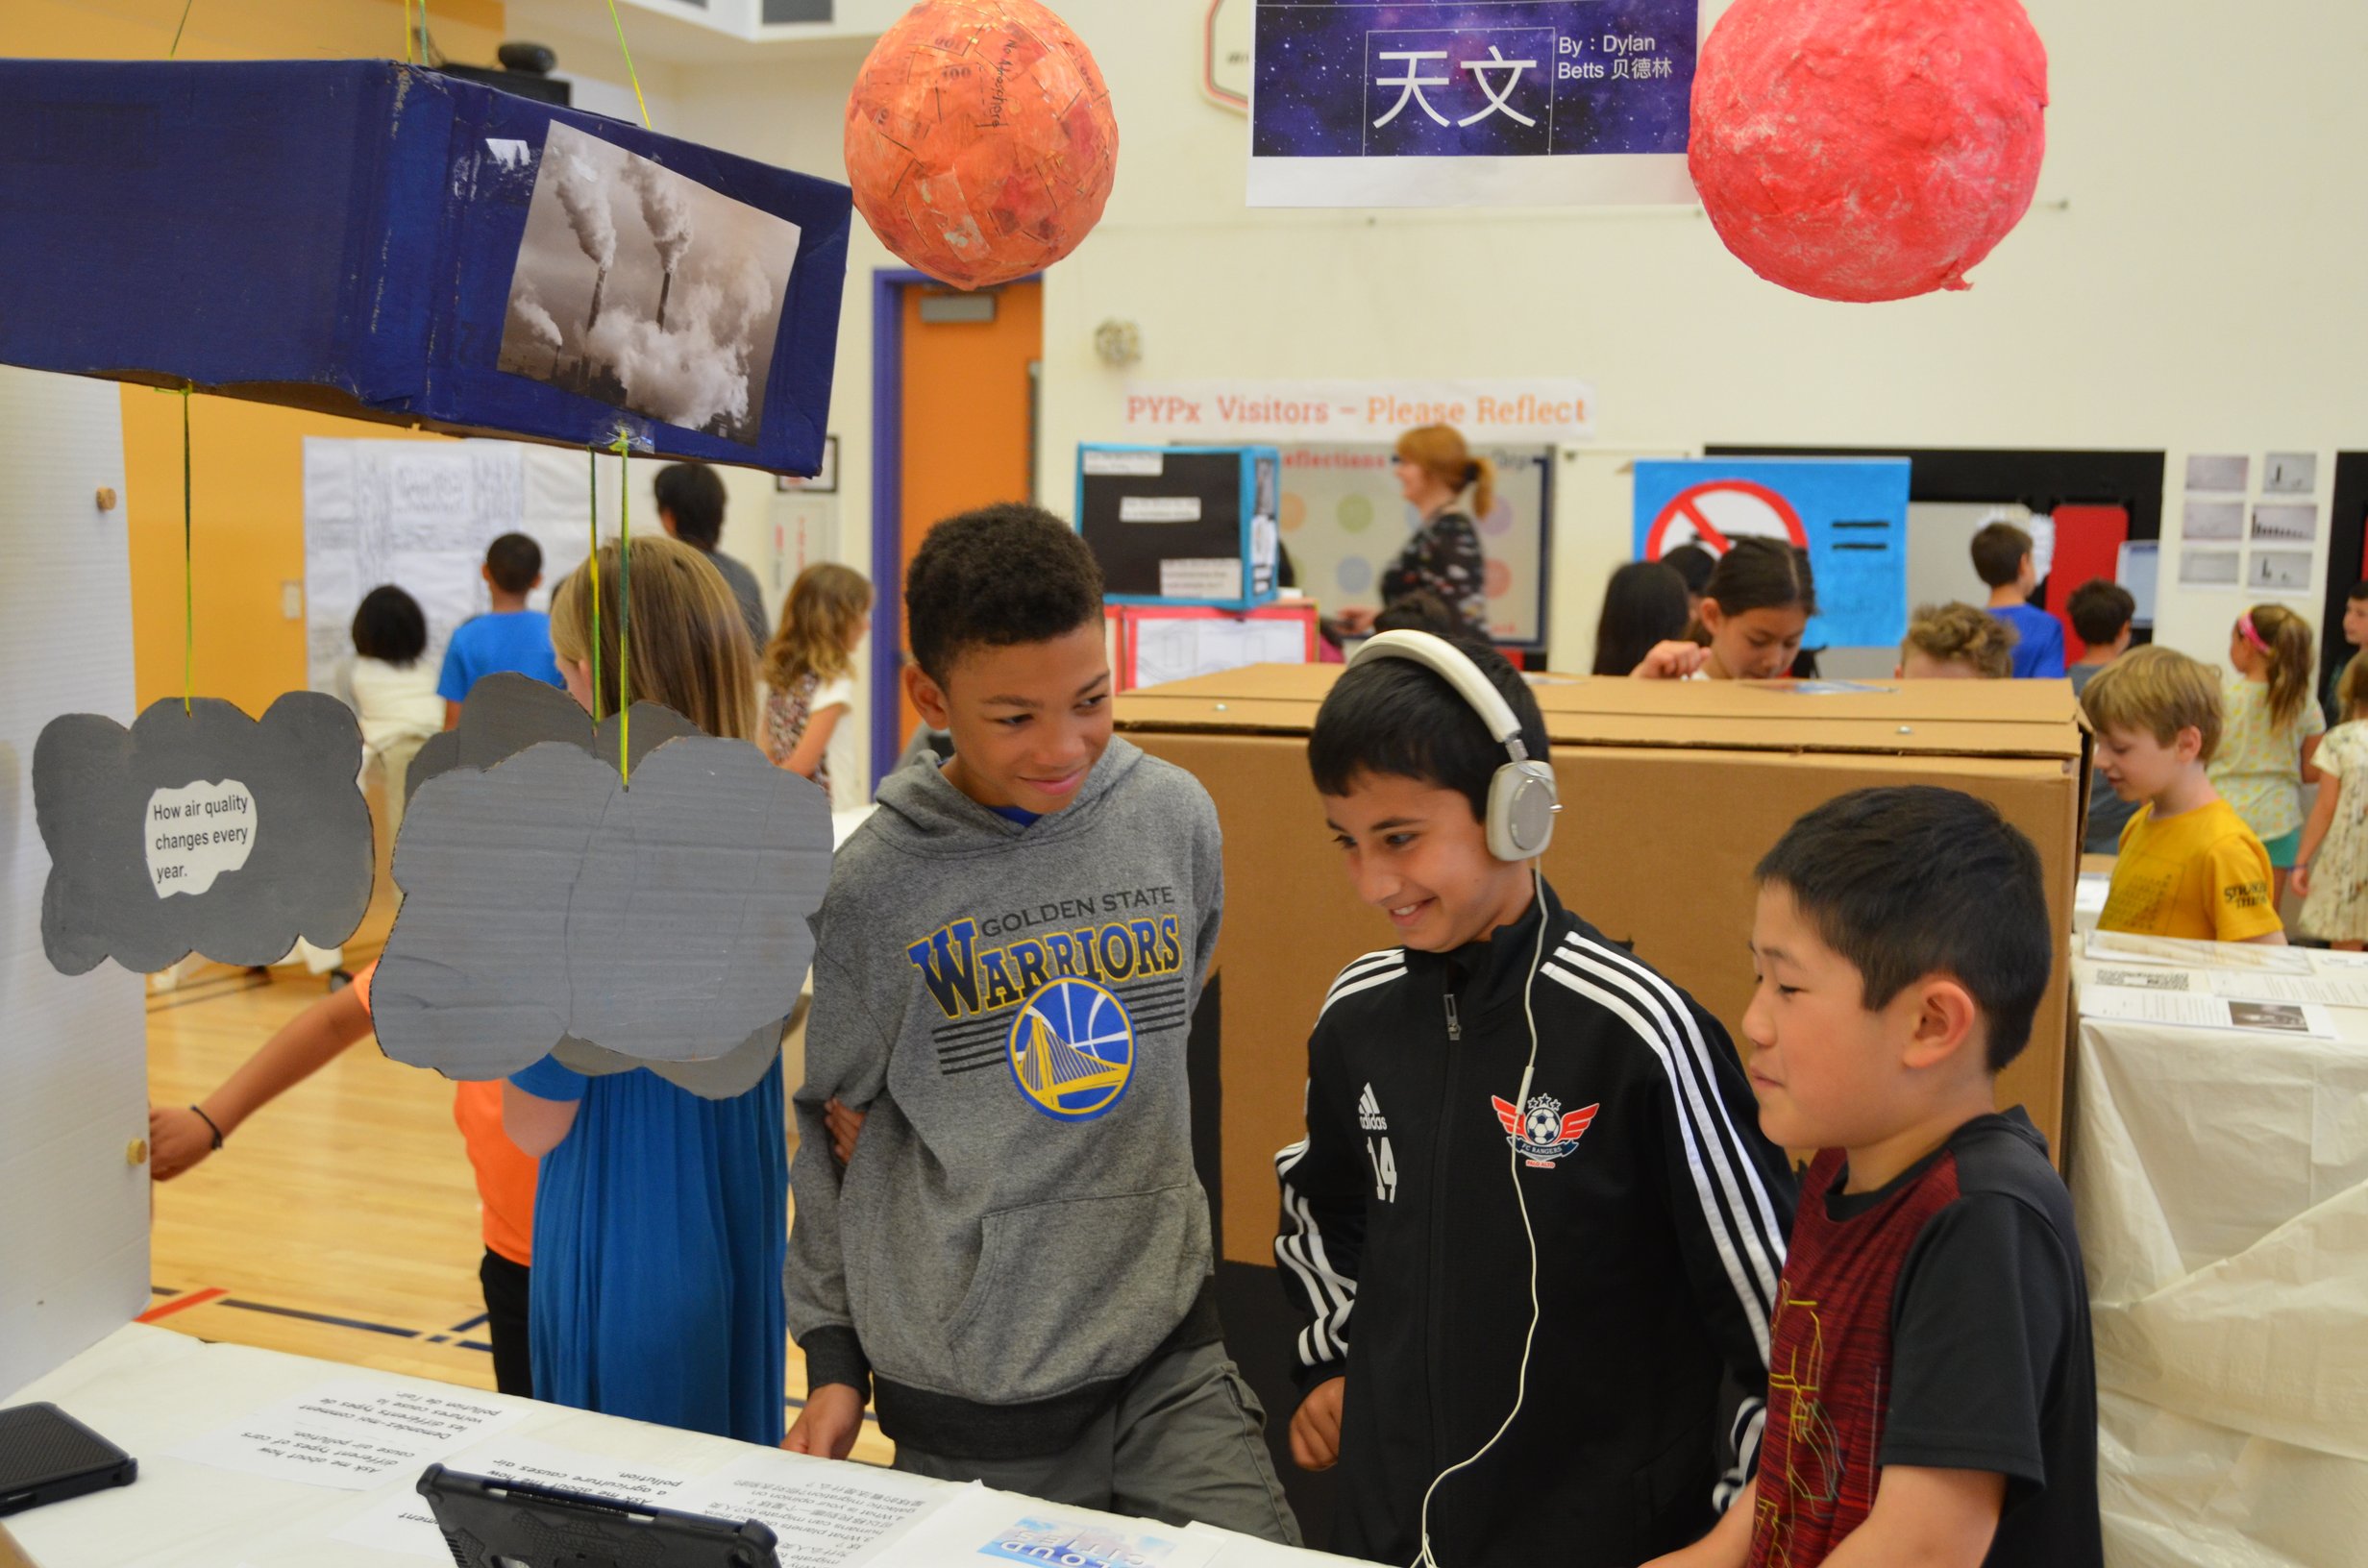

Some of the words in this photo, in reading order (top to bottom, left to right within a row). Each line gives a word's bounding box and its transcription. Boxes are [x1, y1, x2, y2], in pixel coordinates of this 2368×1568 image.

[1558, 37, 1583, 57] By
[1602, 35, 1656, 54] Dylan
[1558, 61, 1605, 80] Betts
[1610, 58, 1673, 81] 贝德林
[1372, 44, 1537, 129] 天文
[1126, 396, 1201, 425] PYPx
[1216, 394, 1329, 425] Visitors
[1366, 395, 1467, 425] Please
[1476, 394, 1587, 426] Reflect
[1279, 450, 1387, 471] eflections
[153, 804, 182, 821] How
[185, 799, 201, 817] air
[205, 794, 249, 818] quality
[155, 831, 210, 851] changes
[212, 827, 249, 845] every
[157, 864, 188, 884] year.
[981, 897, 1096, 938] GOLDEN
[1102, 886, 1175, 913] STATE
[906, 914, 1182, 1020] WARRIORS
[1359, 1113, 1388, 1131] adidas
[1521, 1142, 1531, 1152] FC
[1532, 1145, 1563, 1155] RANGERS
[1367, 1136, 1397, 1204] 14
[299, 1405, 356, 1418] comment
[257, 1447, 285, 1458] how
[293, 1442, 331, 1454] types
[377, 1447, 415, 1458] cause
[286, 1453, 328, 1463] about
[333, 1451, 398, 1466] different
[492, 1458, 516, 1468] air
[353, 1464, 382, 1474] Ask
[518, 1464, 569, 1479] causes
[571, 1475, 653, 1494] agriculture
[617, 1471, 684, 1488] pollution.
[1000, 1539, 1113, 1568] LOUD
